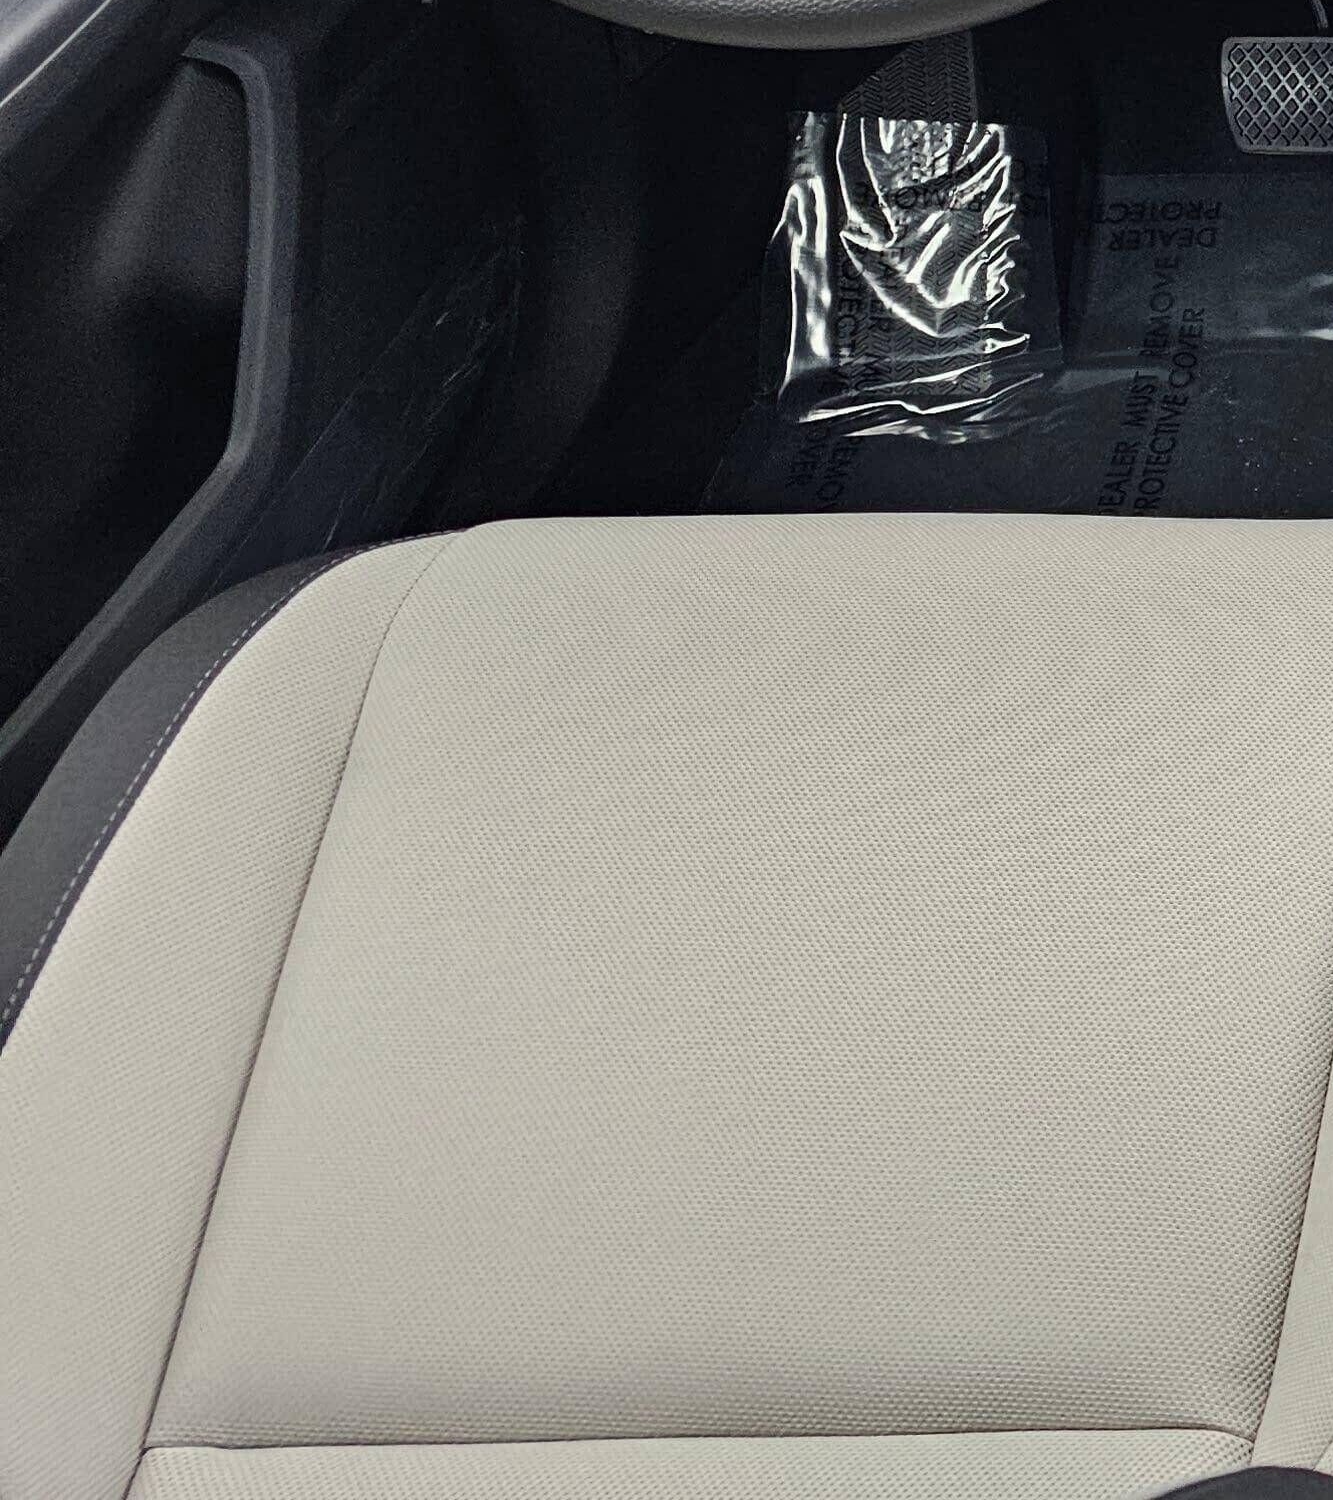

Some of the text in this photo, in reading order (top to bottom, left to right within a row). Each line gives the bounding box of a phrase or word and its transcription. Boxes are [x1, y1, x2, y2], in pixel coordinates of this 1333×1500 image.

[1108, 226, 1218, 251] DEALER
[1122, 253, 1180, 428] MUST REMOVE
[1168, 307, 1206, 389] COVER
